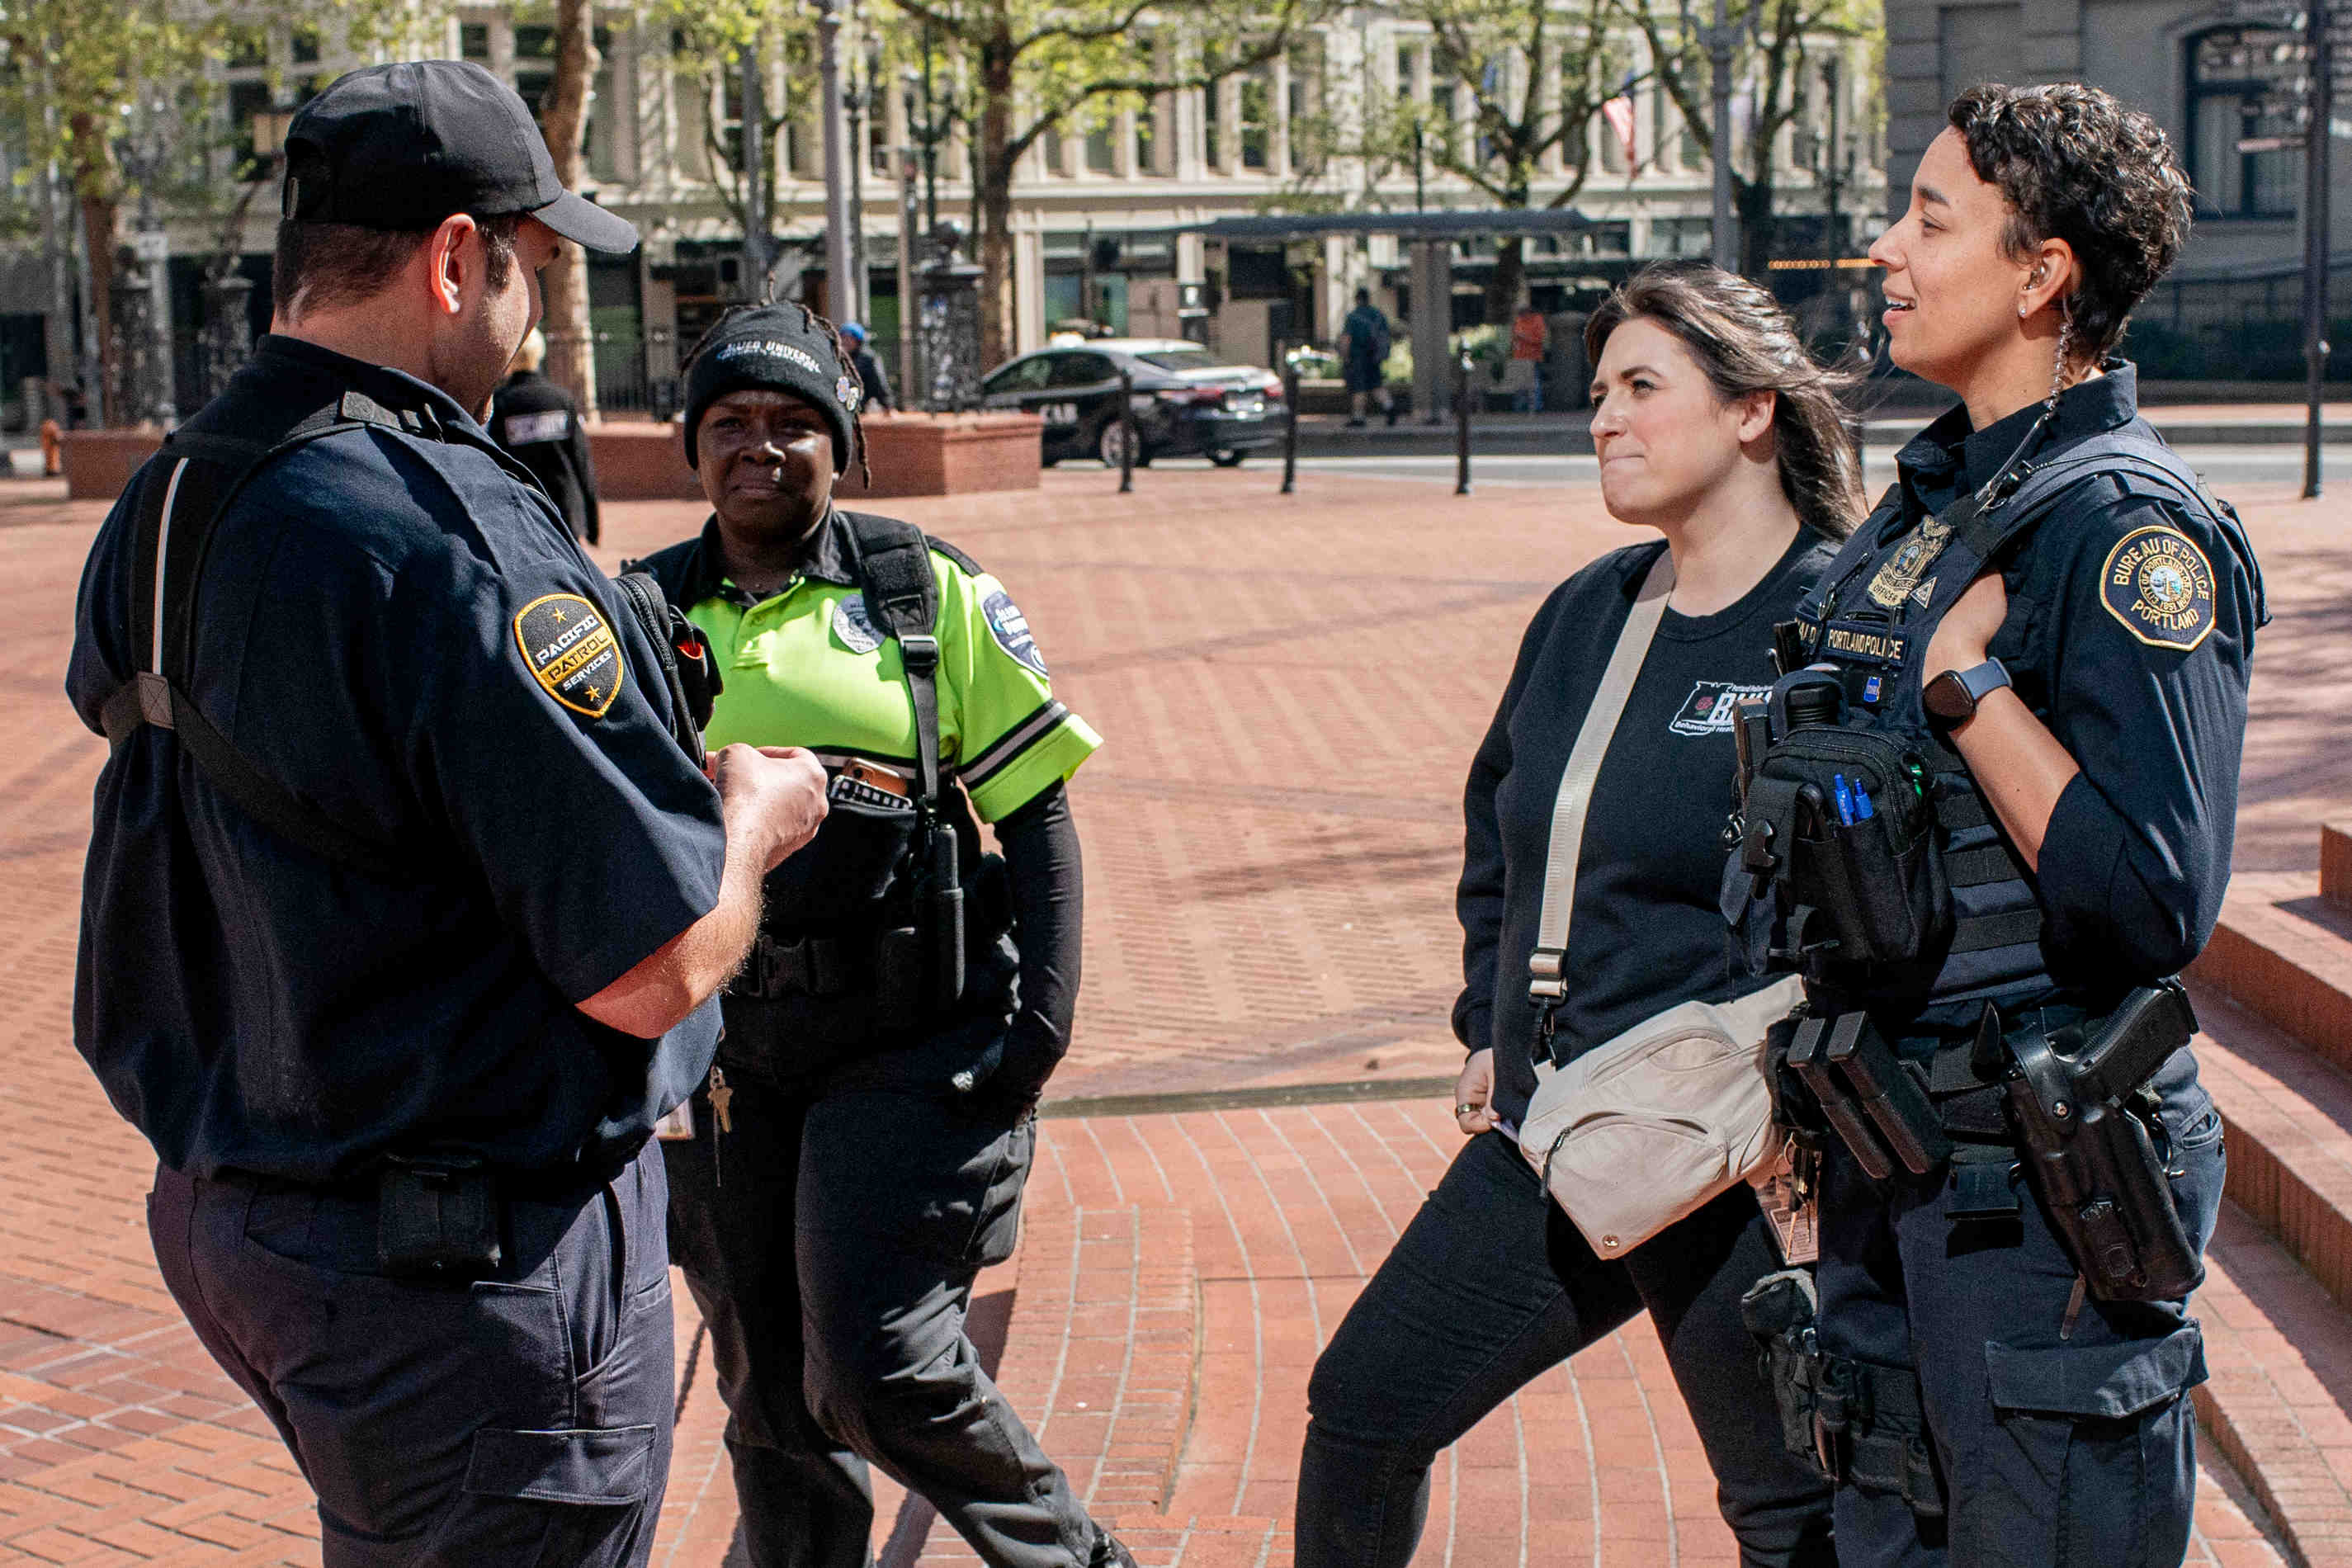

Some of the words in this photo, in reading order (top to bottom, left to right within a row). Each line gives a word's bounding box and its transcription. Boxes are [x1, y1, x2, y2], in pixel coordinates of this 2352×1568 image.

[2113, 537, 2161, 586] BUREAU
[2162, 539, 2180, 556] OF
[2179, 547, 2210, 601] POLICE
[2131, 599, 2199, 631] PORTLAND
[535, 614, 599, 665] PACIFIC
[547, 635, 608, 681] PATROL
[562, 649, 613, 692] SERVICES
